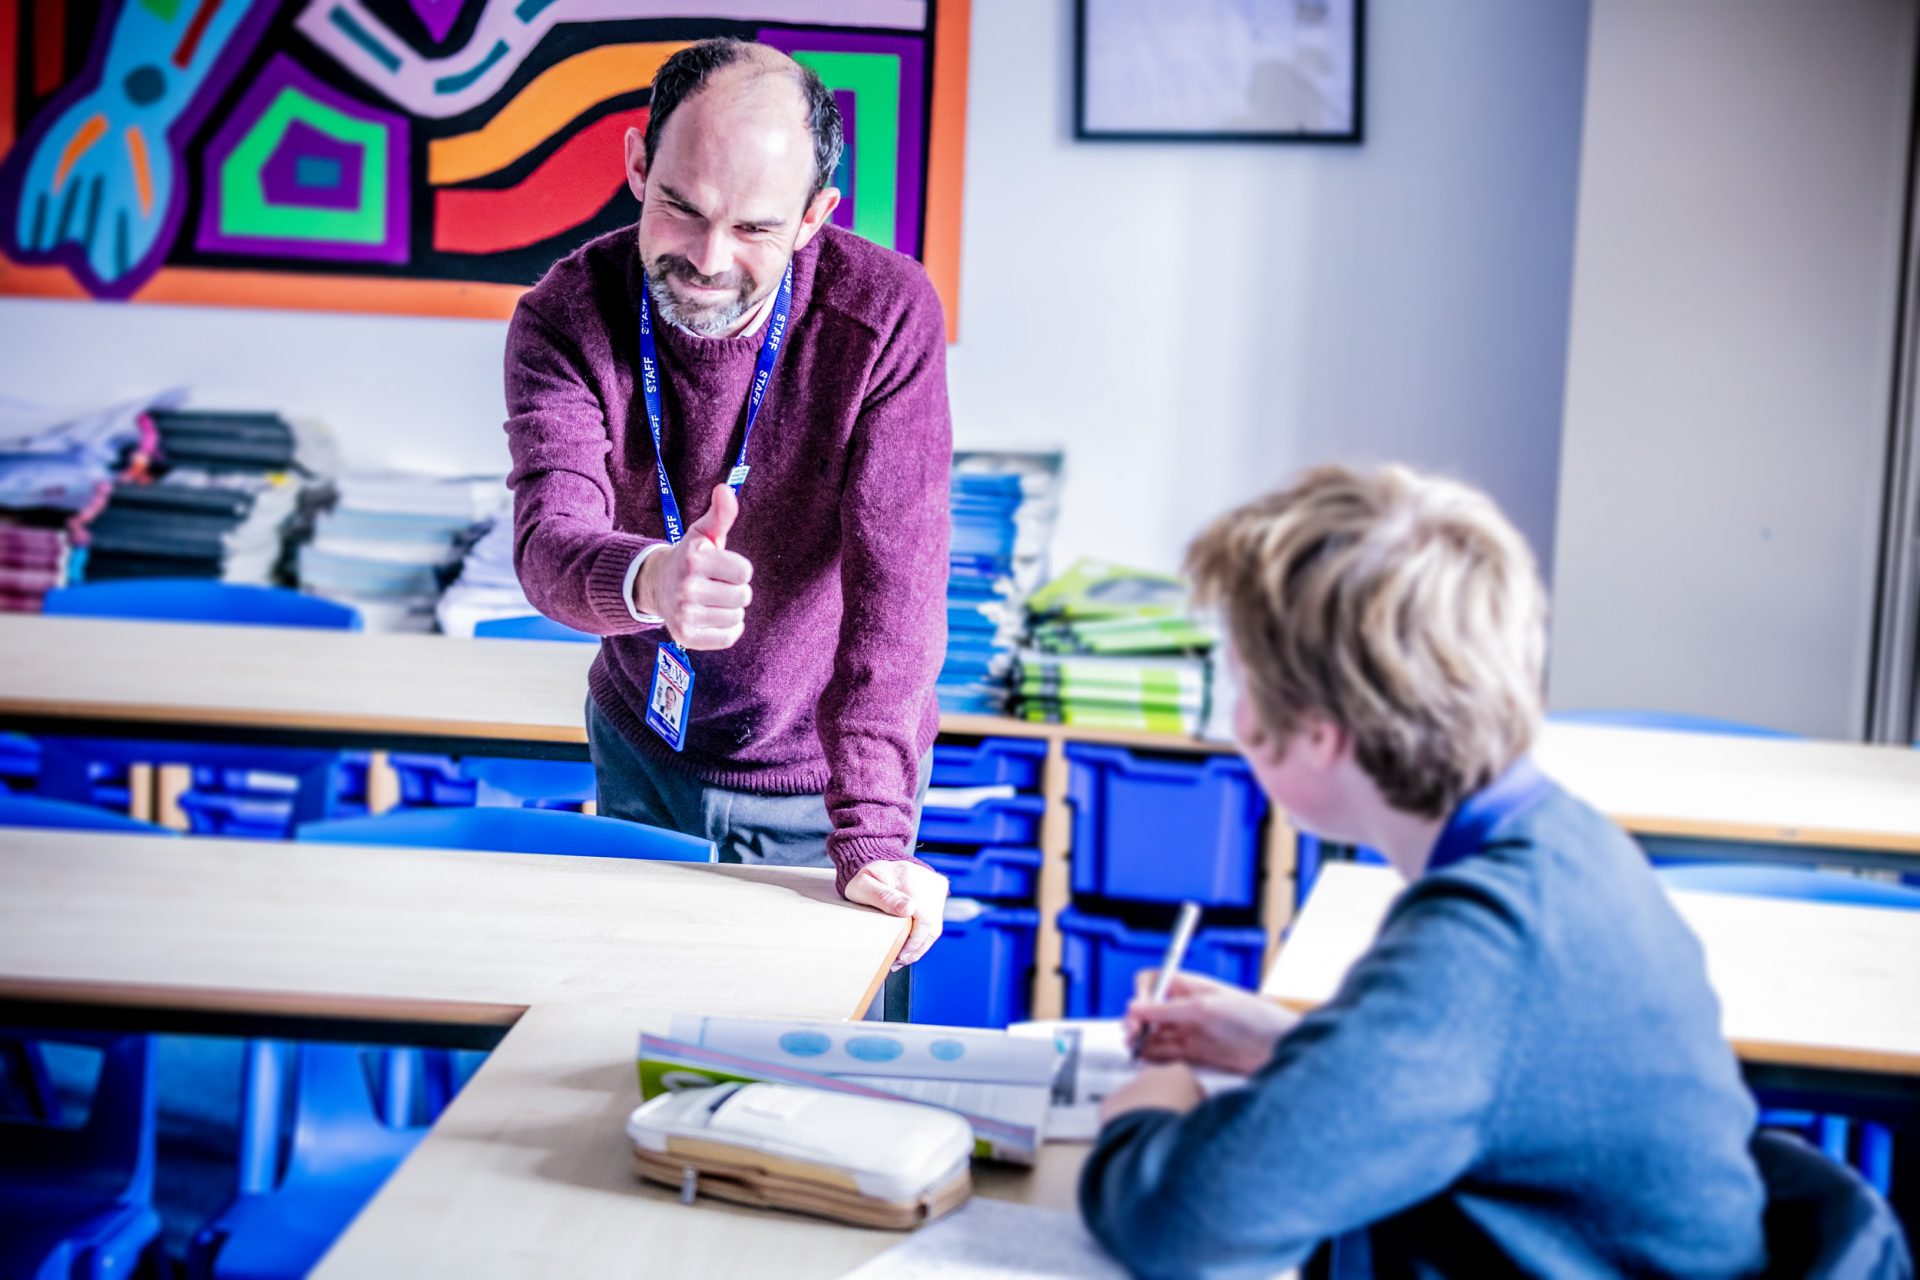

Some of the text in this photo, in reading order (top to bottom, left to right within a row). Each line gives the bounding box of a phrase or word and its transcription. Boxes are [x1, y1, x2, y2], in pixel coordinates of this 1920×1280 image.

[768, 313, 786, 351] STAFF
[643, 356, 657, 393] STAFF
[753, 369, 769, 406] STAFF
